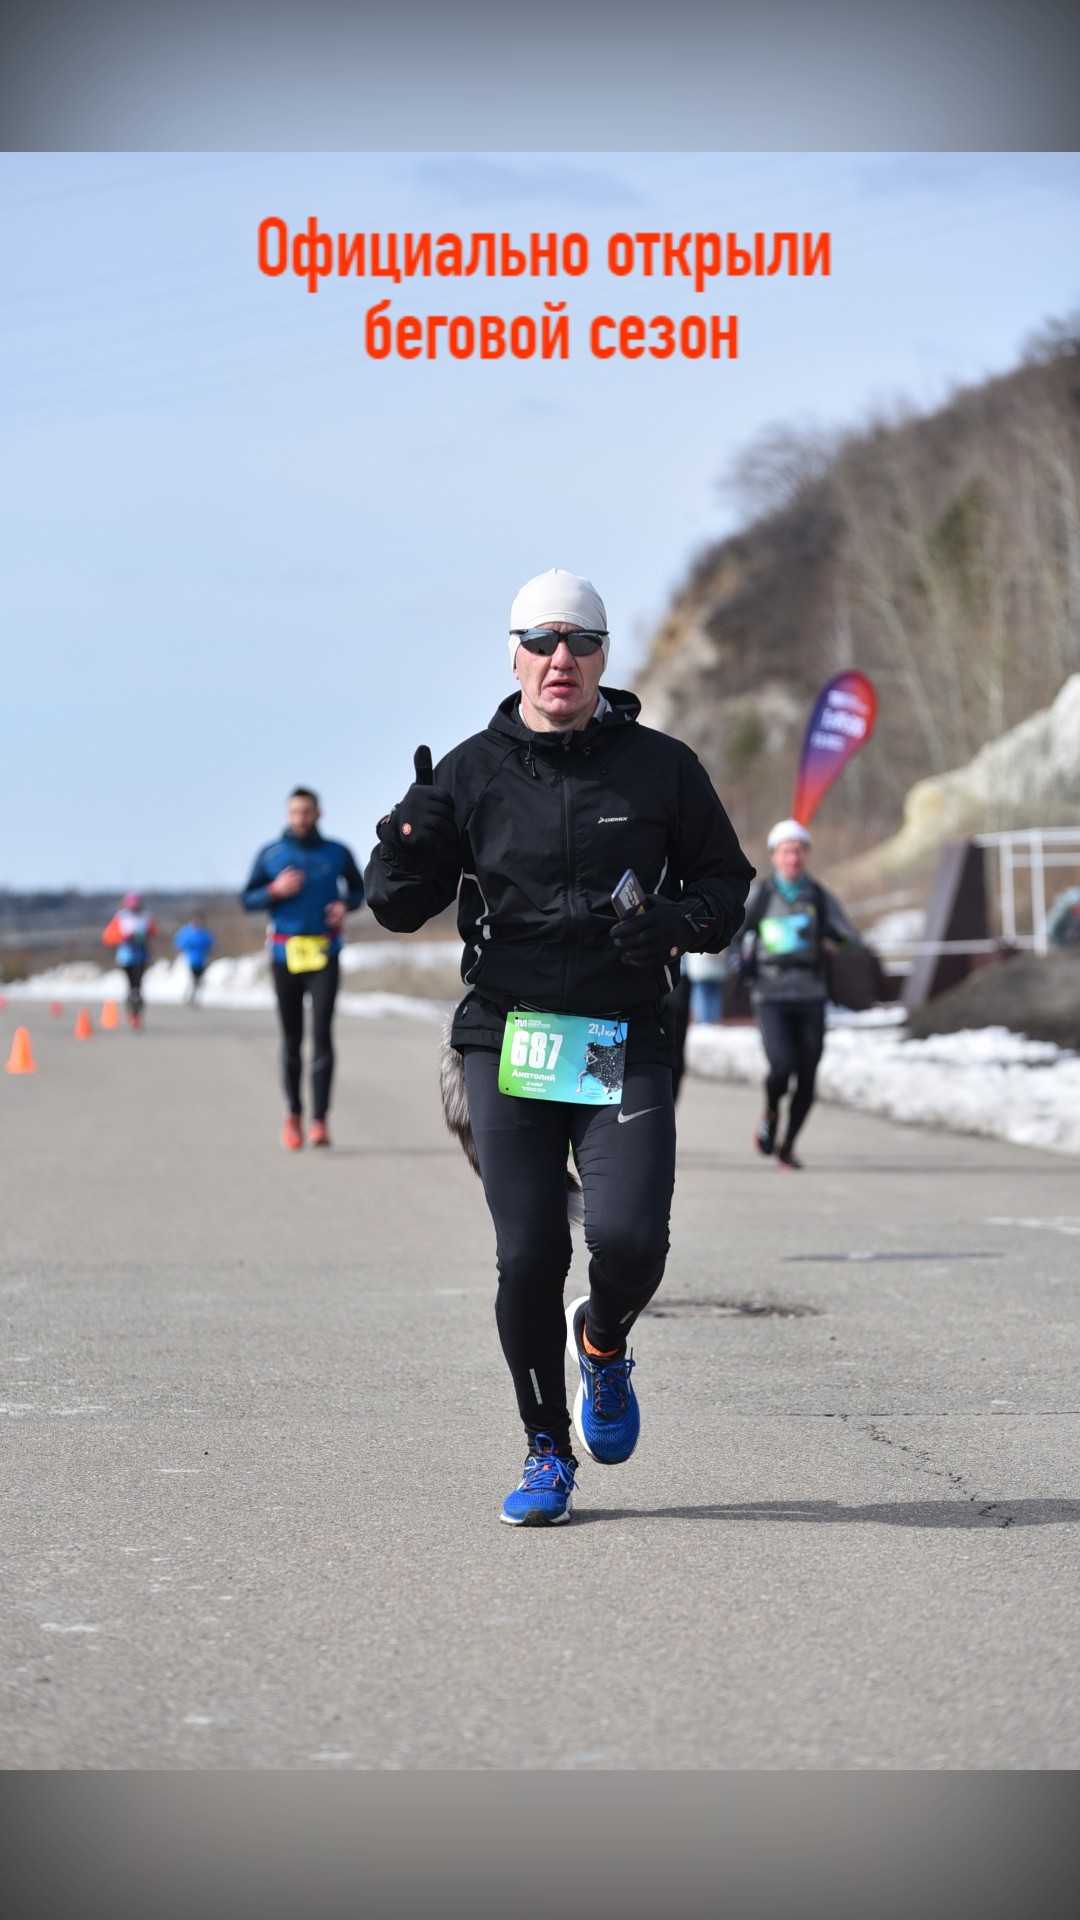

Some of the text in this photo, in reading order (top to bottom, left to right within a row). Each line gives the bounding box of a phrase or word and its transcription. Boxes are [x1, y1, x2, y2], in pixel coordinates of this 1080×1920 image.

[588, 1022, 605, 1037] 21,1
[510, 1031, 563, 1070] 687
[511, 1068, 555, 1082] Анатолий
